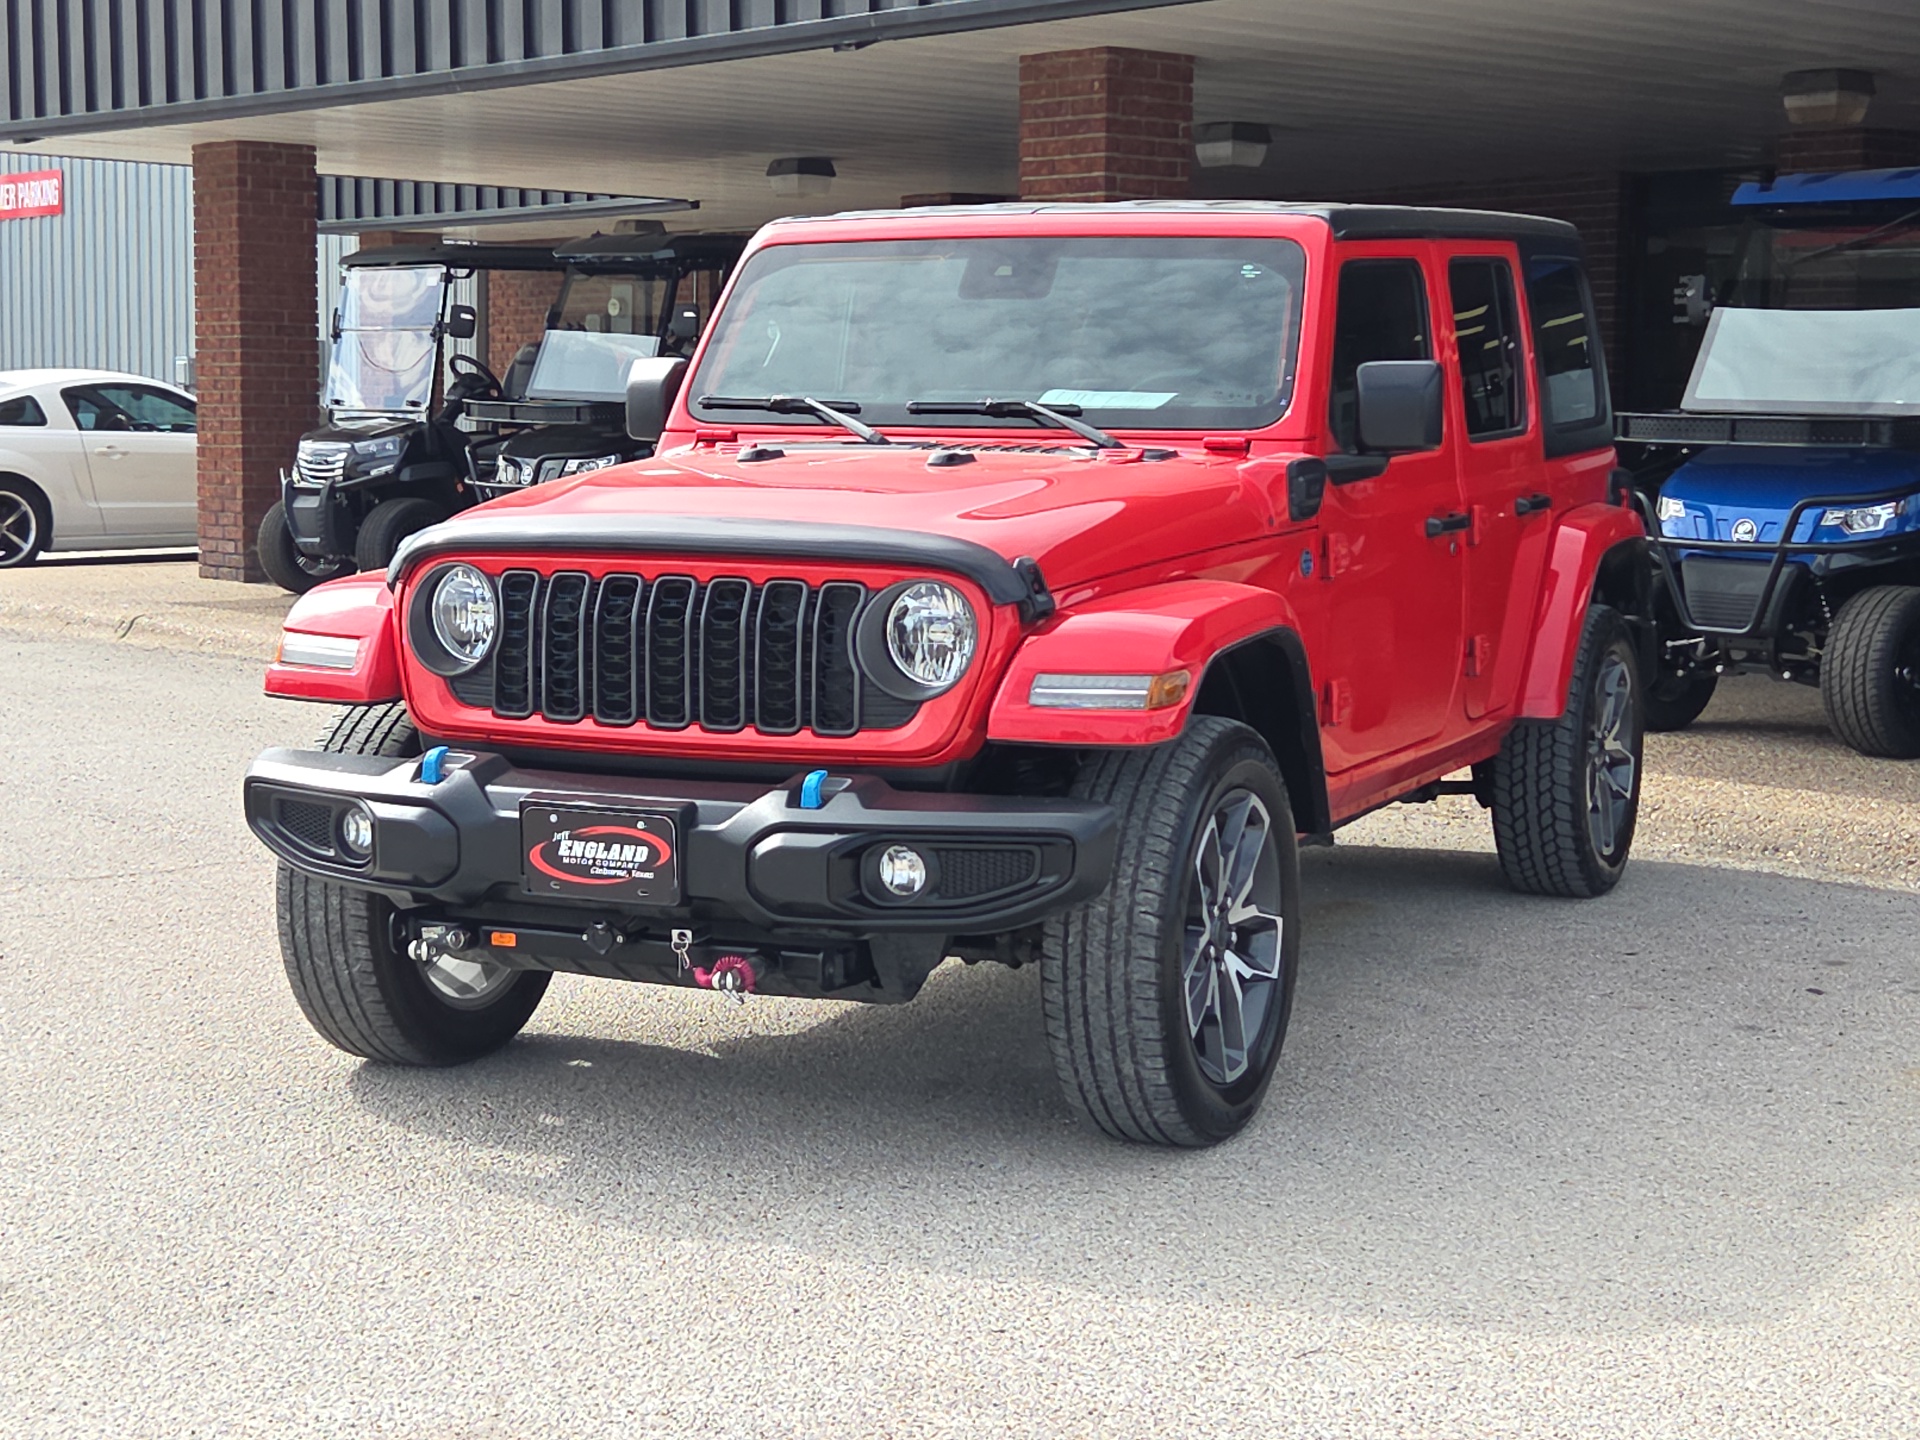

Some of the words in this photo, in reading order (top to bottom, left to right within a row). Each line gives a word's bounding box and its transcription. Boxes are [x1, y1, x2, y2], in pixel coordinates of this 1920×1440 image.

[17, 178, 59, 208] PARKING
[552, 831, 571, 842] Jeff
[558, 840, 649, 862] ENGLAND
[563, 857, 593, 865] MOTOR
[595, 860, 639, 869] COMPANY
[631, 870, 654, 879] Texas
